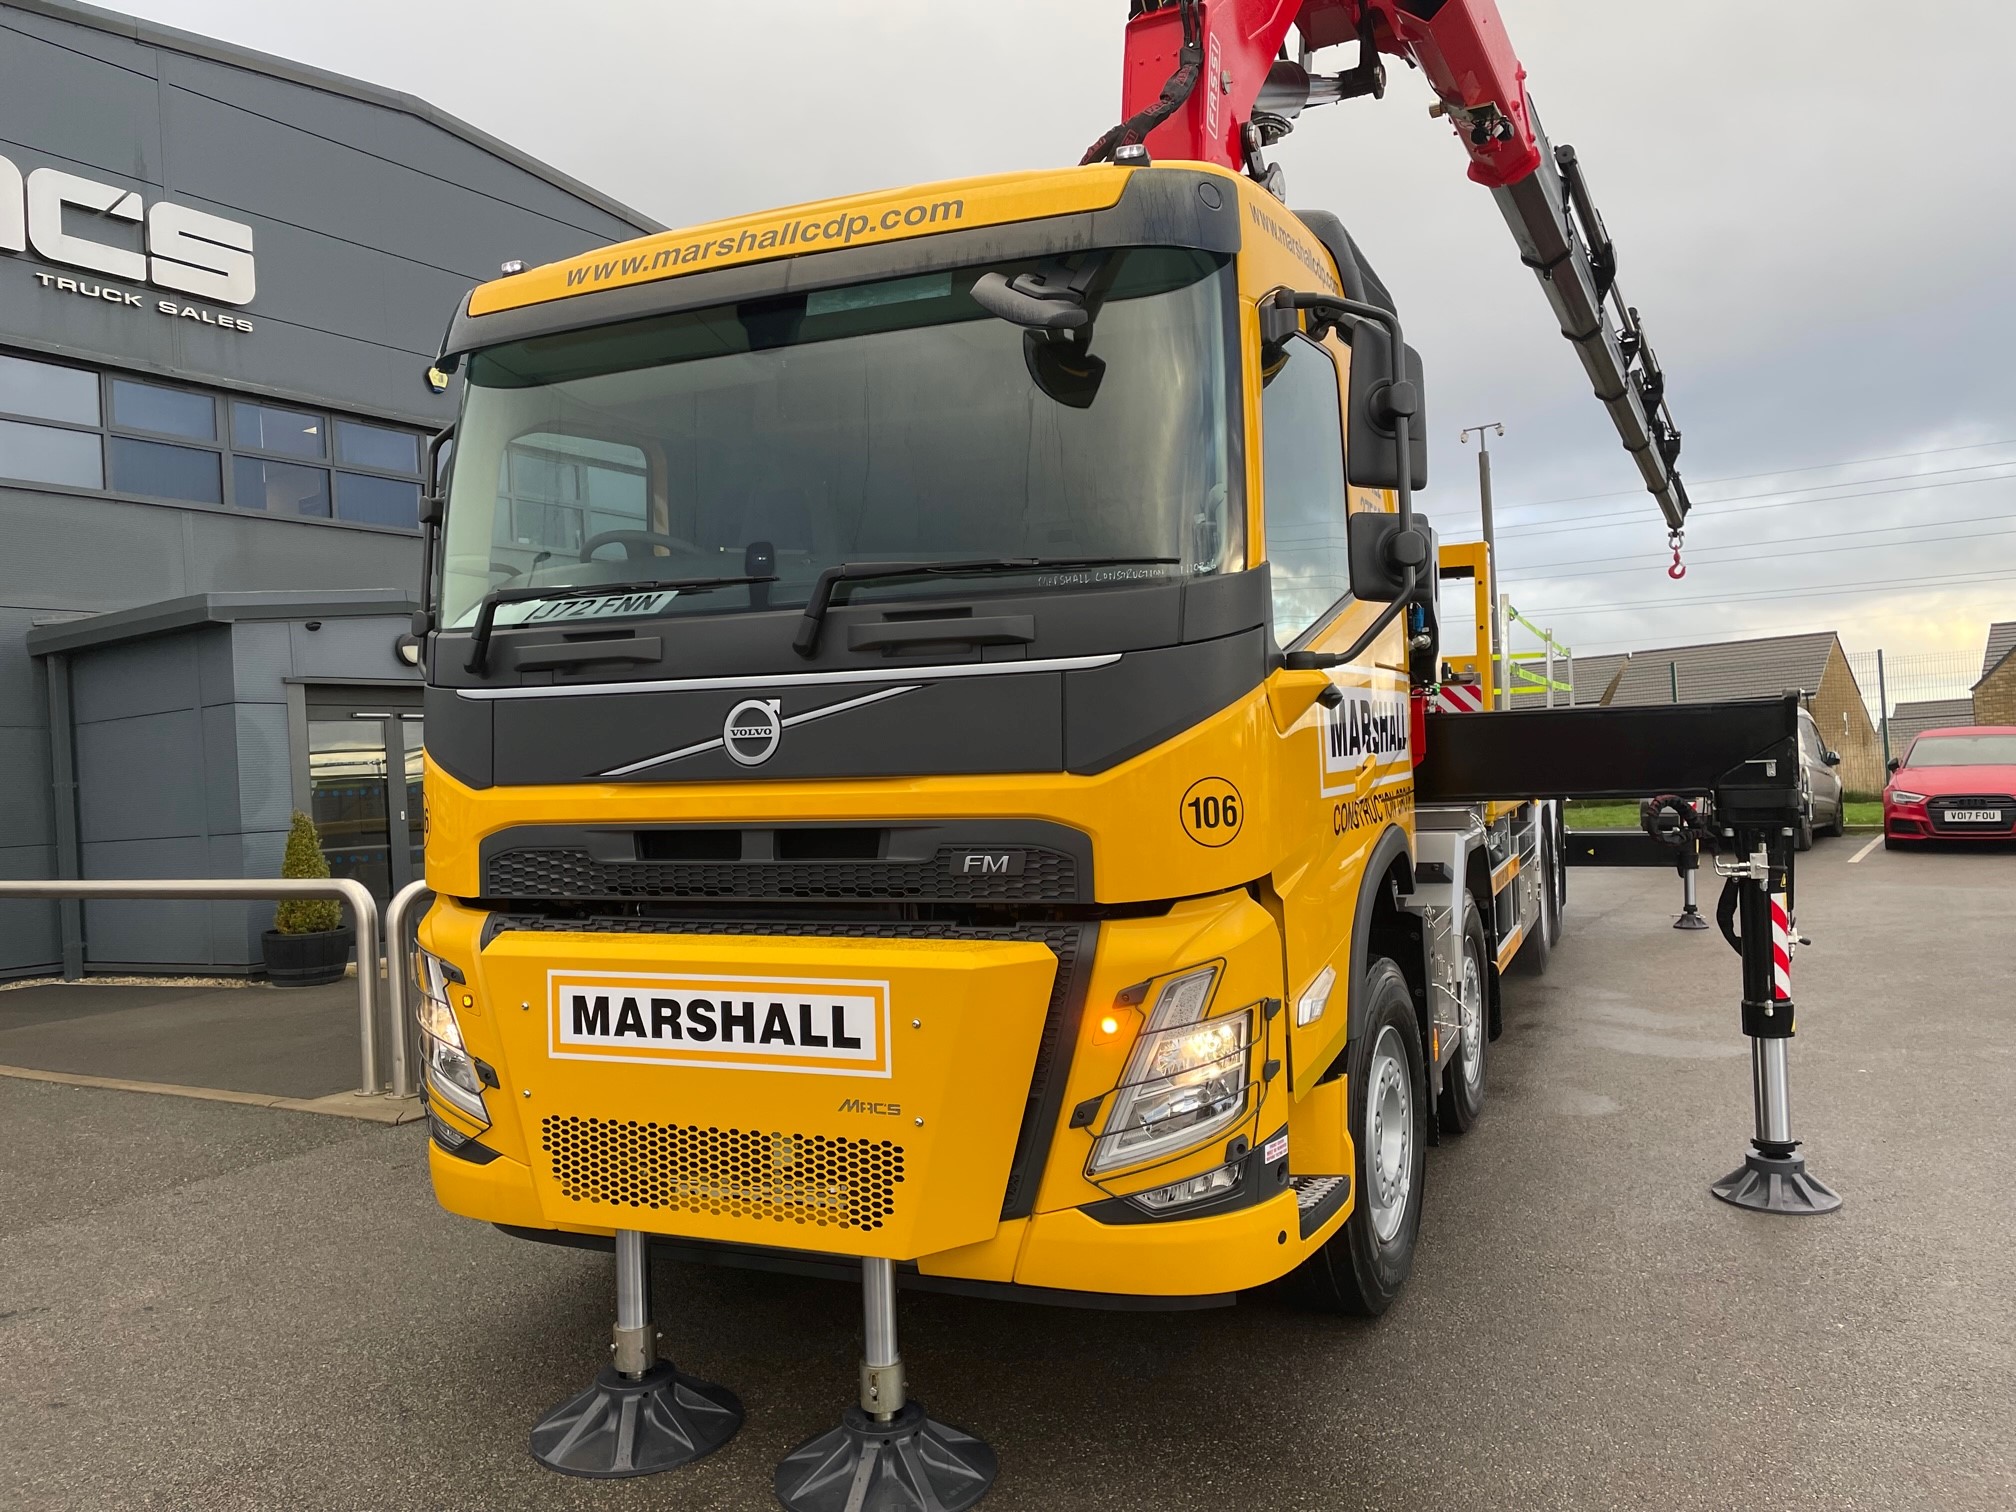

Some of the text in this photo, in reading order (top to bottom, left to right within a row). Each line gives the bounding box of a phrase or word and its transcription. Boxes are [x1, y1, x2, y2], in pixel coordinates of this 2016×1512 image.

[1209, 43, 1219, 128] FASSI
[567, 198, 964, 287] www.marshallcdp.com
[36, 272, 254, 332] TRUCK SALES
[594, 593, 664, 615] FNN
[730, 728, 772, 736] VOLVO
[1329, 699, 1407, 758] MARSHALL
[1188, 795, 1238, 829] 106
[1975, 811, 1996, 820] FOU
[963, 855, 1010, 873] FM
[572, 995, 862, 1050] MARSHALL
